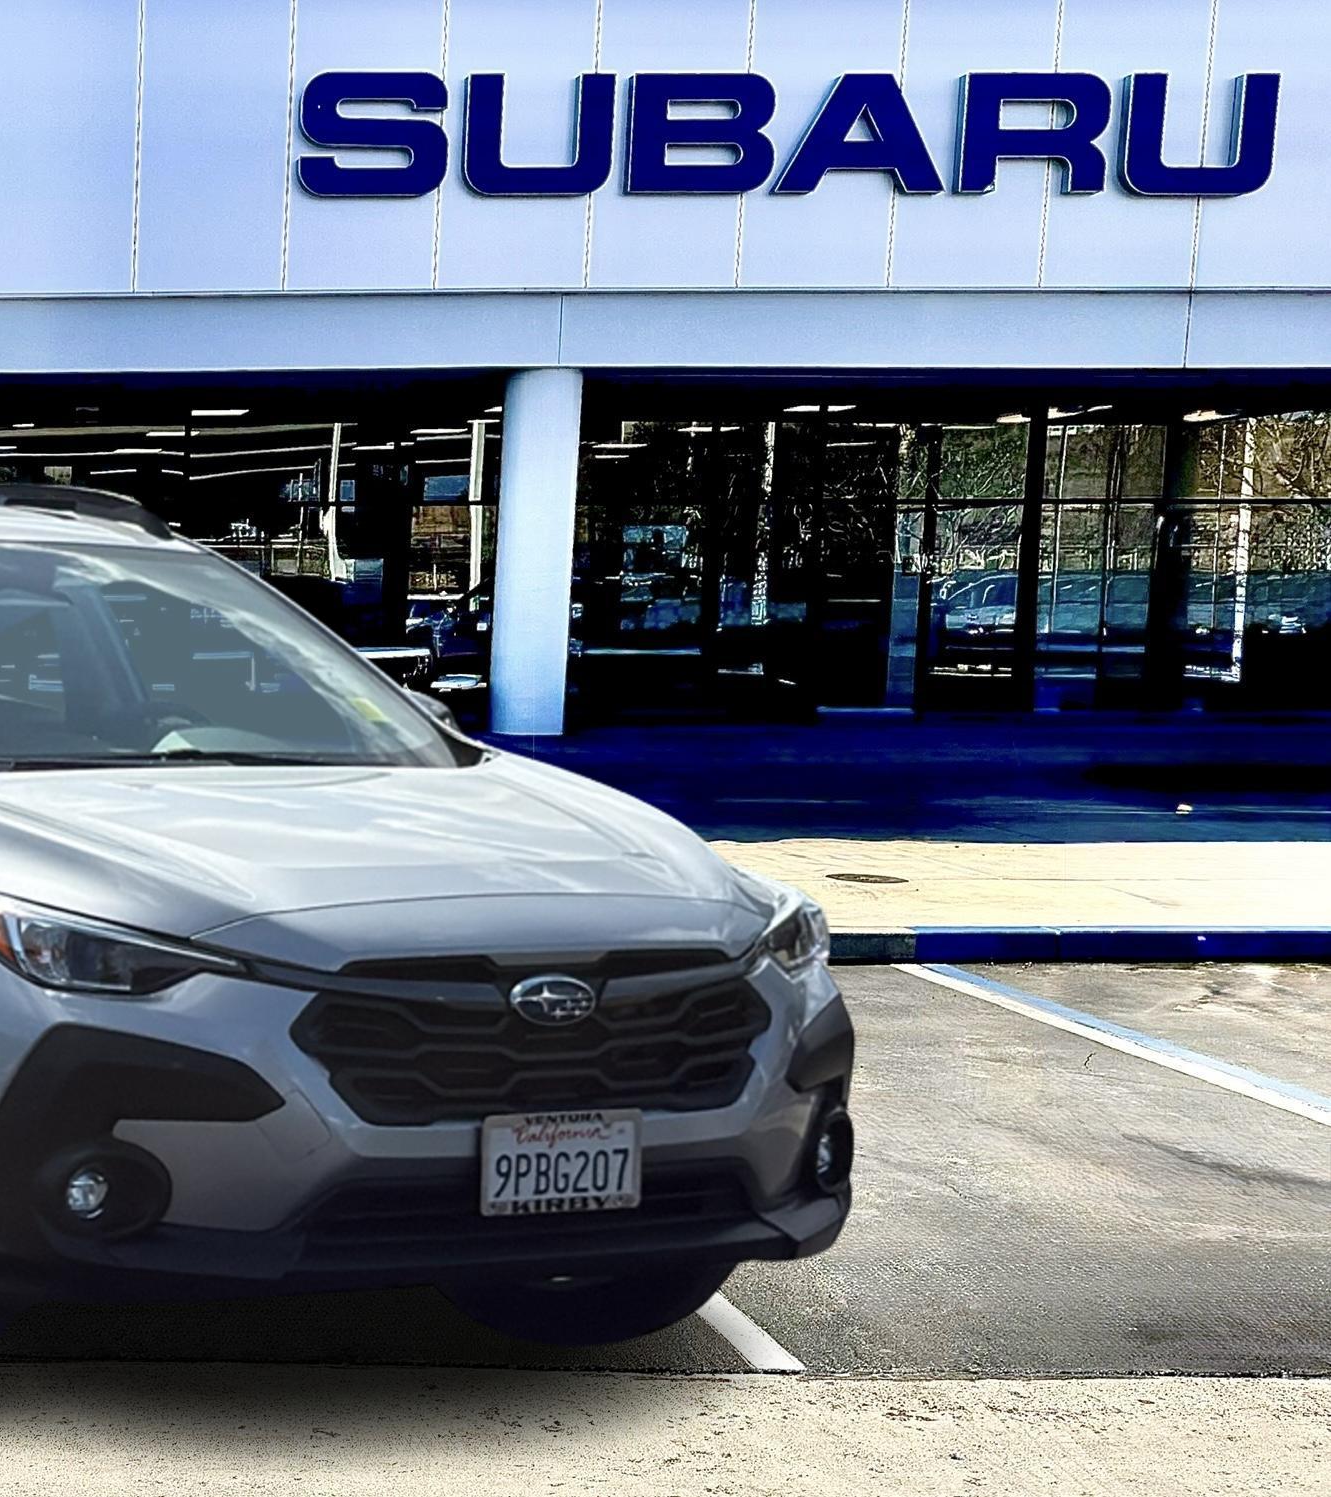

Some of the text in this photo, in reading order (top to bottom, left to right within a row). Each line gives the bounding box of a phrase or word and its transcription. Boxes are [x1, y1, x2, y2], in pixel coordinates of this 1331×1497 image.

[297, 71, 1282, 197] SUBARU
[524, 1112, 604, 1125] VENTURA
[512, 1123, 610, 1148] California
[494, 1147, 629, 1198] 9PBG207
[511, 1196, 611, 1214] KIRBY
